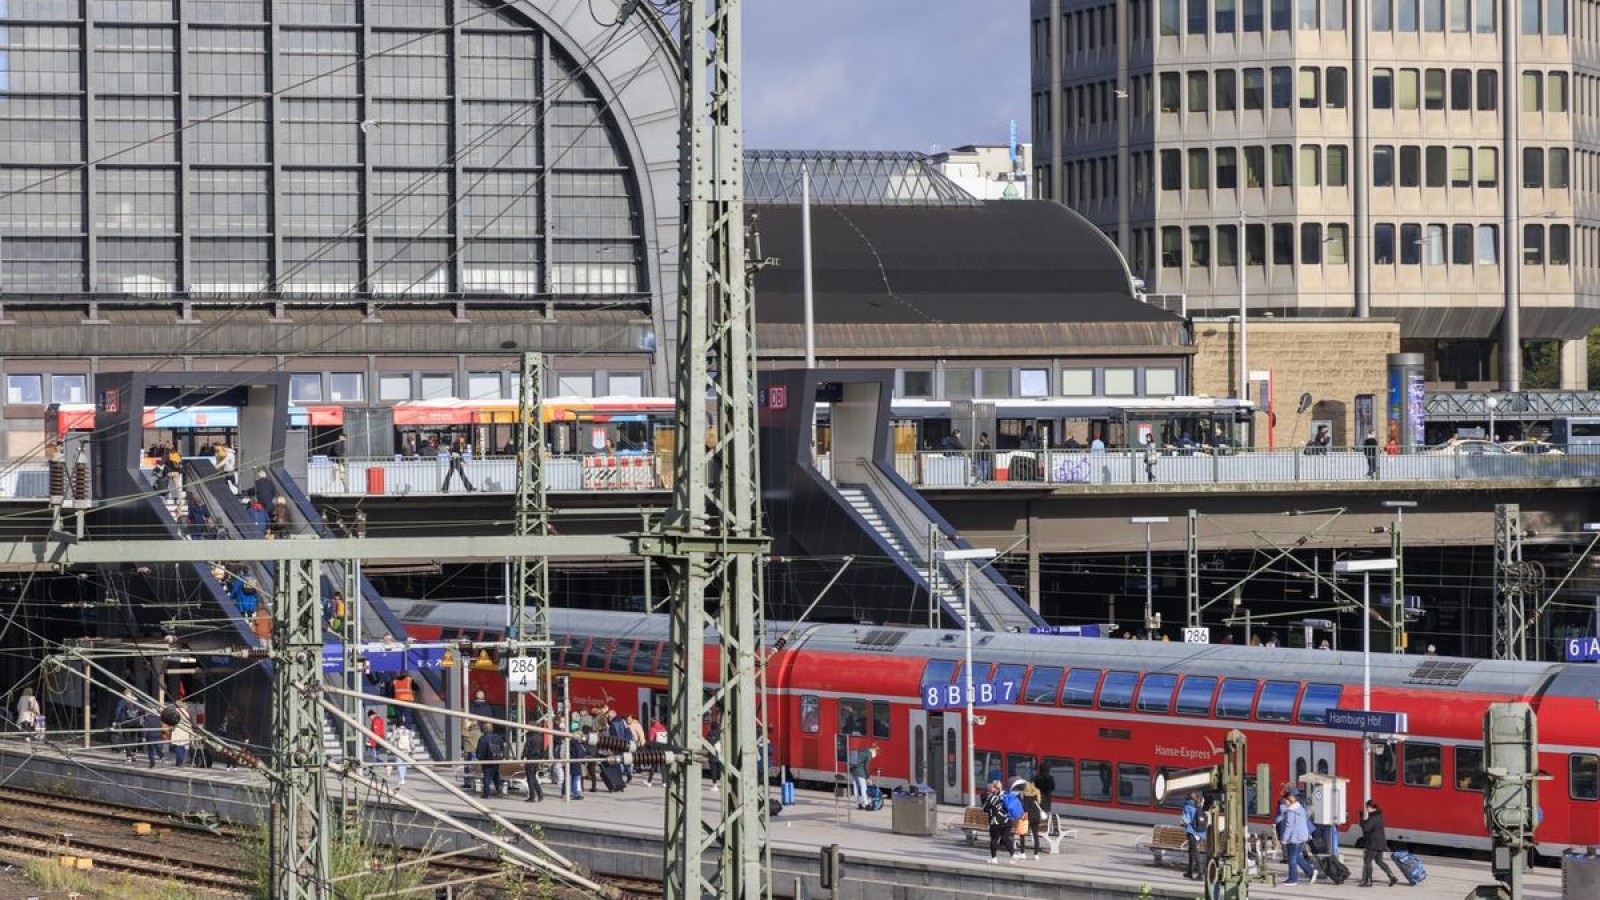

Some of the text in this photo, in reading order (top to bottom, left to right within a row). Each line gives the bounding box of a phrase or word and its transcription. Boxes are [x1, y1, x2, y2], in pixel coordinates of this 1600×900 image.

[770, 388, 784, 407] DB
[1187, 630, 1207, 641] 286
[1570, 637, 1600, 656] 6 A
[511, 659, 535, 673] 286
[519, 674, 528, 687] 4
[927, 681, 1013, 706] 8 B B 7
[1329, 711, 1382, 727] Hamburg Hbf
